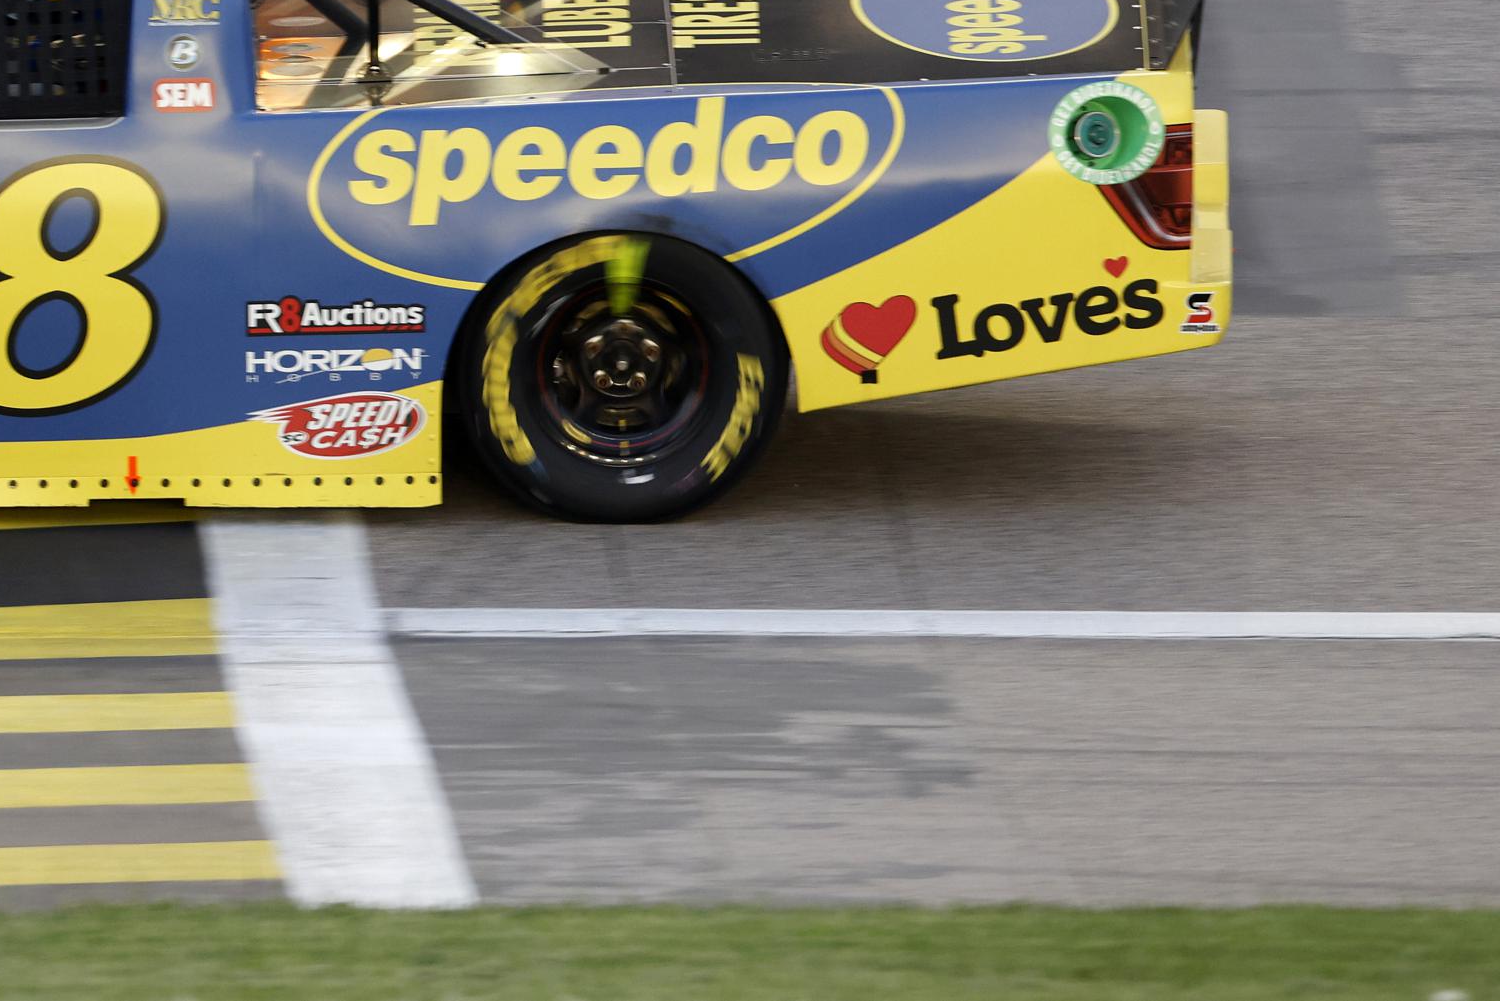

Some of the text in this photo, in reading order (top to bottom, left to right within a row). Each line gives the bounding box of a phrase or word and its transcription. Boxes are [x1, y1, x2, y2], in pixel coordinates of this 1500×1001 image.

[157, 82, 213, 108] SEM
[348, 96, 869, 226] speedco
[246, 348, 424, 374] HORIZON
[304, 400, 418, 430] SPEEDY
